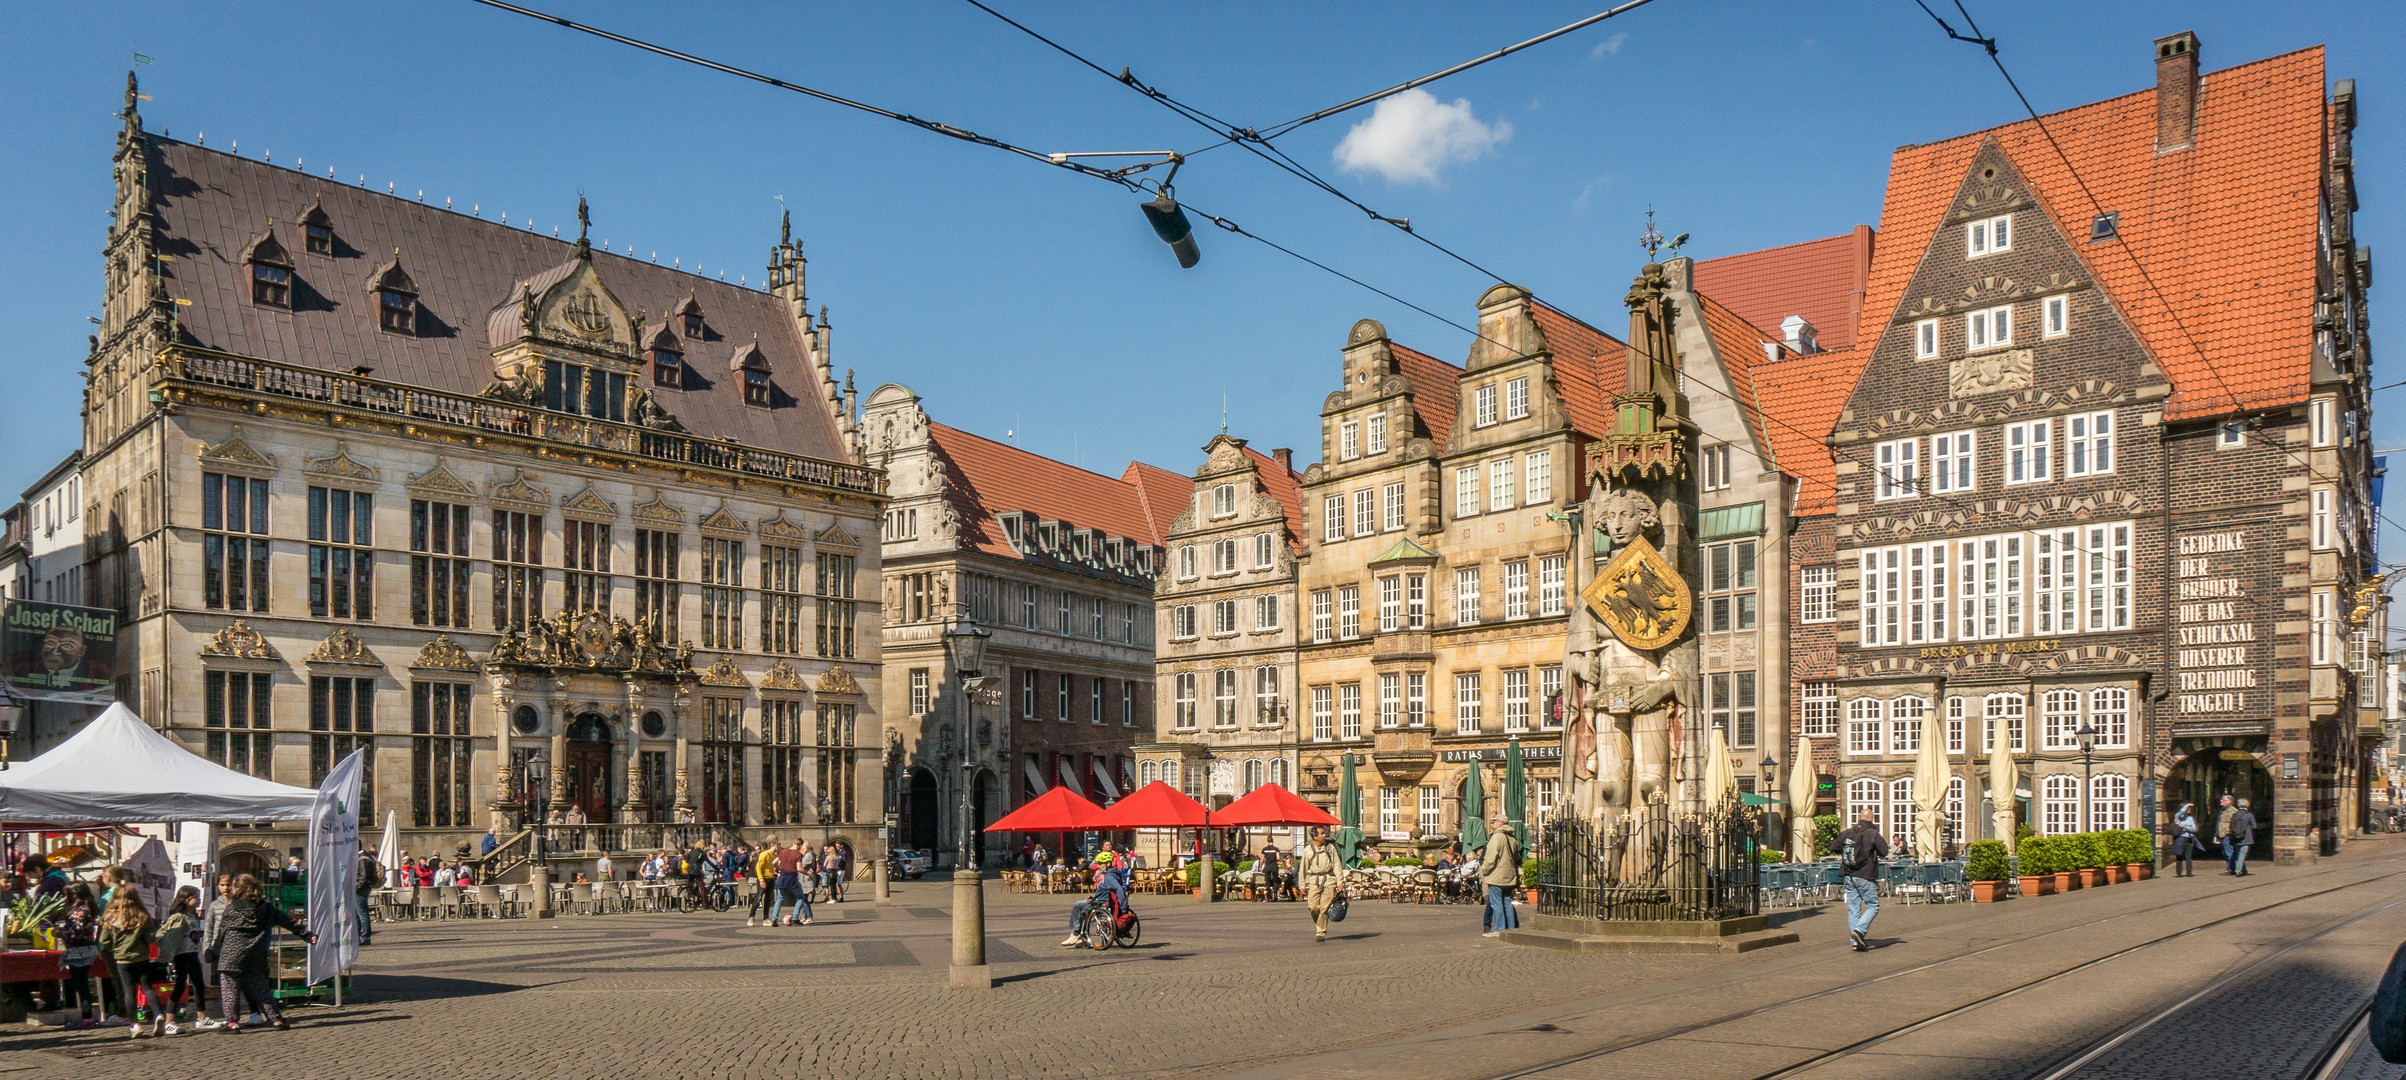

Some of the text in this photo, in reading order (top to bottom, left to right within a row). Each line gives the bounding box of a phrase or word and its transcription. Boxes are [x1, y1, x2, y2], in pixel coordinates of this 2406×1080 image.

[2179, 531, 2245, 555] GEDENKE
[2179, 558, 2208, 578] DER
[2179, 577, 2246, 600] BRÜDER,
[9, 604, 115, 635] Josef Scharl
[2179, 601, 2235, 623] DIE DAS
[2179, 623, 2256, 645] SCHICKSAL
[1975, 643, 1998, 655] AM
[2004, 640, 2061, 654] MARKT
[2179, 646, 2246, 668] UNSERER
[2178, 669, 2256, 691] TRENNUNG
[2178, 693, 2234, 713] TRAGEN
[1499, 746, 1562, 759] ATHEKE
